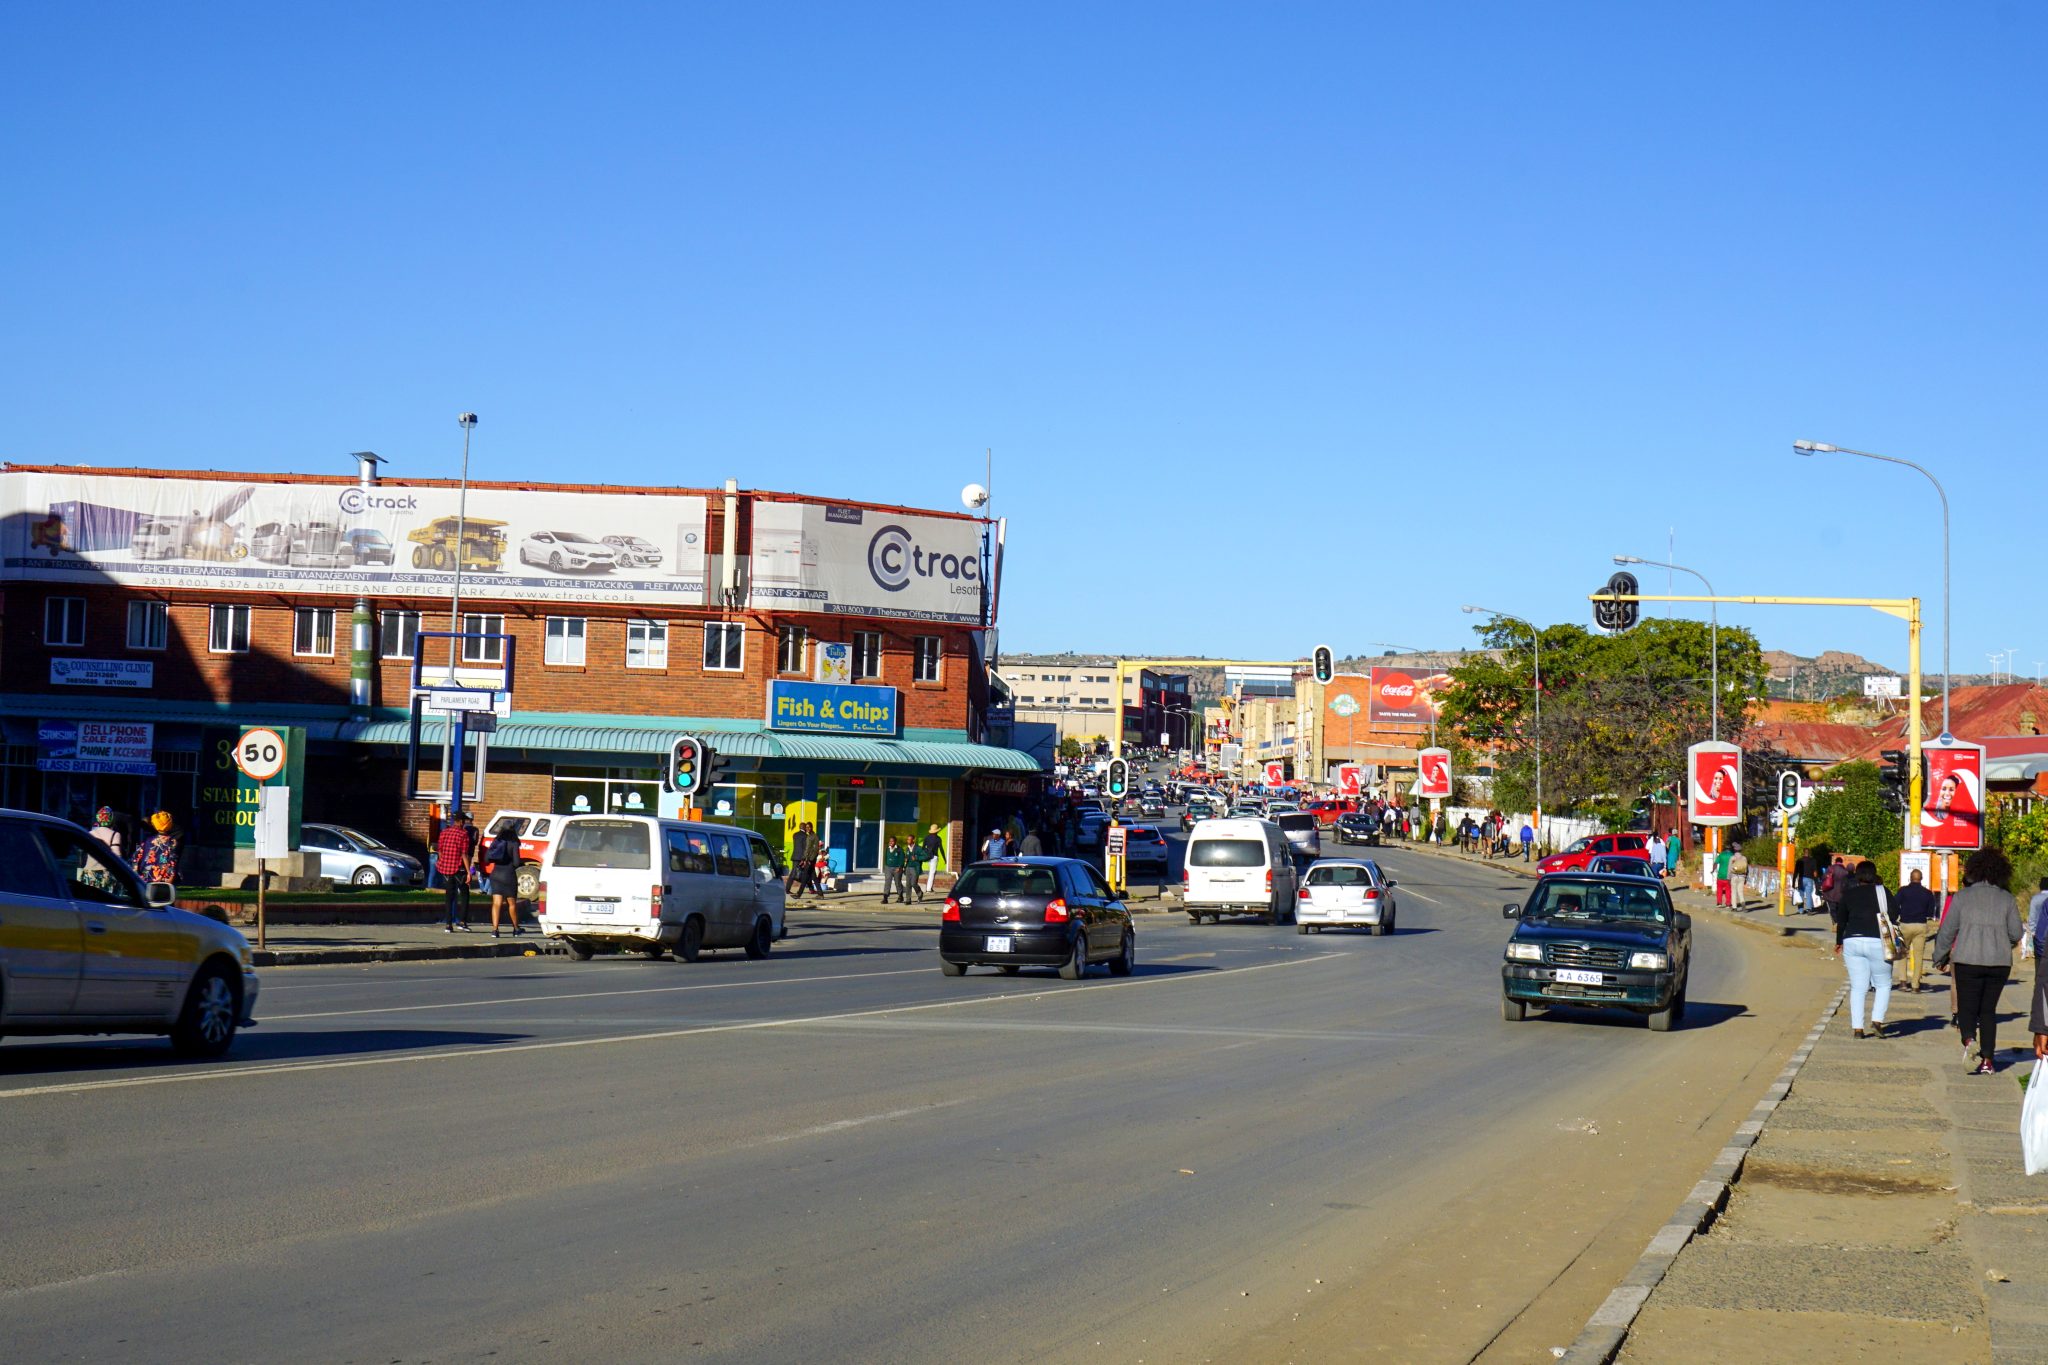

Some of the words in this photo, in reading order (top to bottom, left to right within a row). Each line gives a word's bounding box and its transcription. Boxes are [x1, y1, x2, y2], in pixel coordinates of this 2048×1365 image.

[137, 564, 174, 574] VEHICLE
[178, 566, 237, 577] TELEMATICS
[267, 570, 294, 579] FLEET
[297, 571, 371, 581] MANAGEMENT
[390, 573, 420, 582] ASSET
[471, 575, 522, 586] SOFTWARE
[543, 579, 581, 588] VEHICLE
[583, 580, 634, 590] TRACKING
[144, 577, 172, 586] 2831
[178, 578, 209, 587] 8003
[220, 580, 249, 589] 5376
[257, 581, 285, 591] 6178
[318, 583, 388, 594] THETSANE
[395, 585, 443, 595] OFFICE
[513, 589, 635, 602] www.ctrack.co.ls
[643, 582, 670, 591] FLEET
[951, 583, 982, 596] Lesoth
[785, 589, 828, 600] SOFTWARE
[877, 608, 908, 618] Thetsane
[908, 611, 931, 620] Office
[932, 612, 948, 621] Park
[70, 661, 124, 673] COUNSELLING
[126, 663, 151, 673] CLINIC
[1381, 684, 1415, 697] Coca-Cola
[440, 696, 467, 705] PARLIAMENT
[468, 697, 480, 705] ROAD
[777, 697, 815, 717] Fish
[820, 700, 835, 719] &
[840, 700, 889, 724] Chips
[83, 724, 148, 737] CELLPHONE
[82, 735, 108, 744] SALE
[80, 745, 112, 757] PHONE
[245, 743, 277, 763] 50
[37, 758, 71, 771] GLASS
[203, 787, 242, 804] STAR
[245, 788, 260, 804] LI
[215, 810, 257, 827] GROU
[1566, 972, 1572, 981] A
[1577, 974, 1601, 983] 6365
